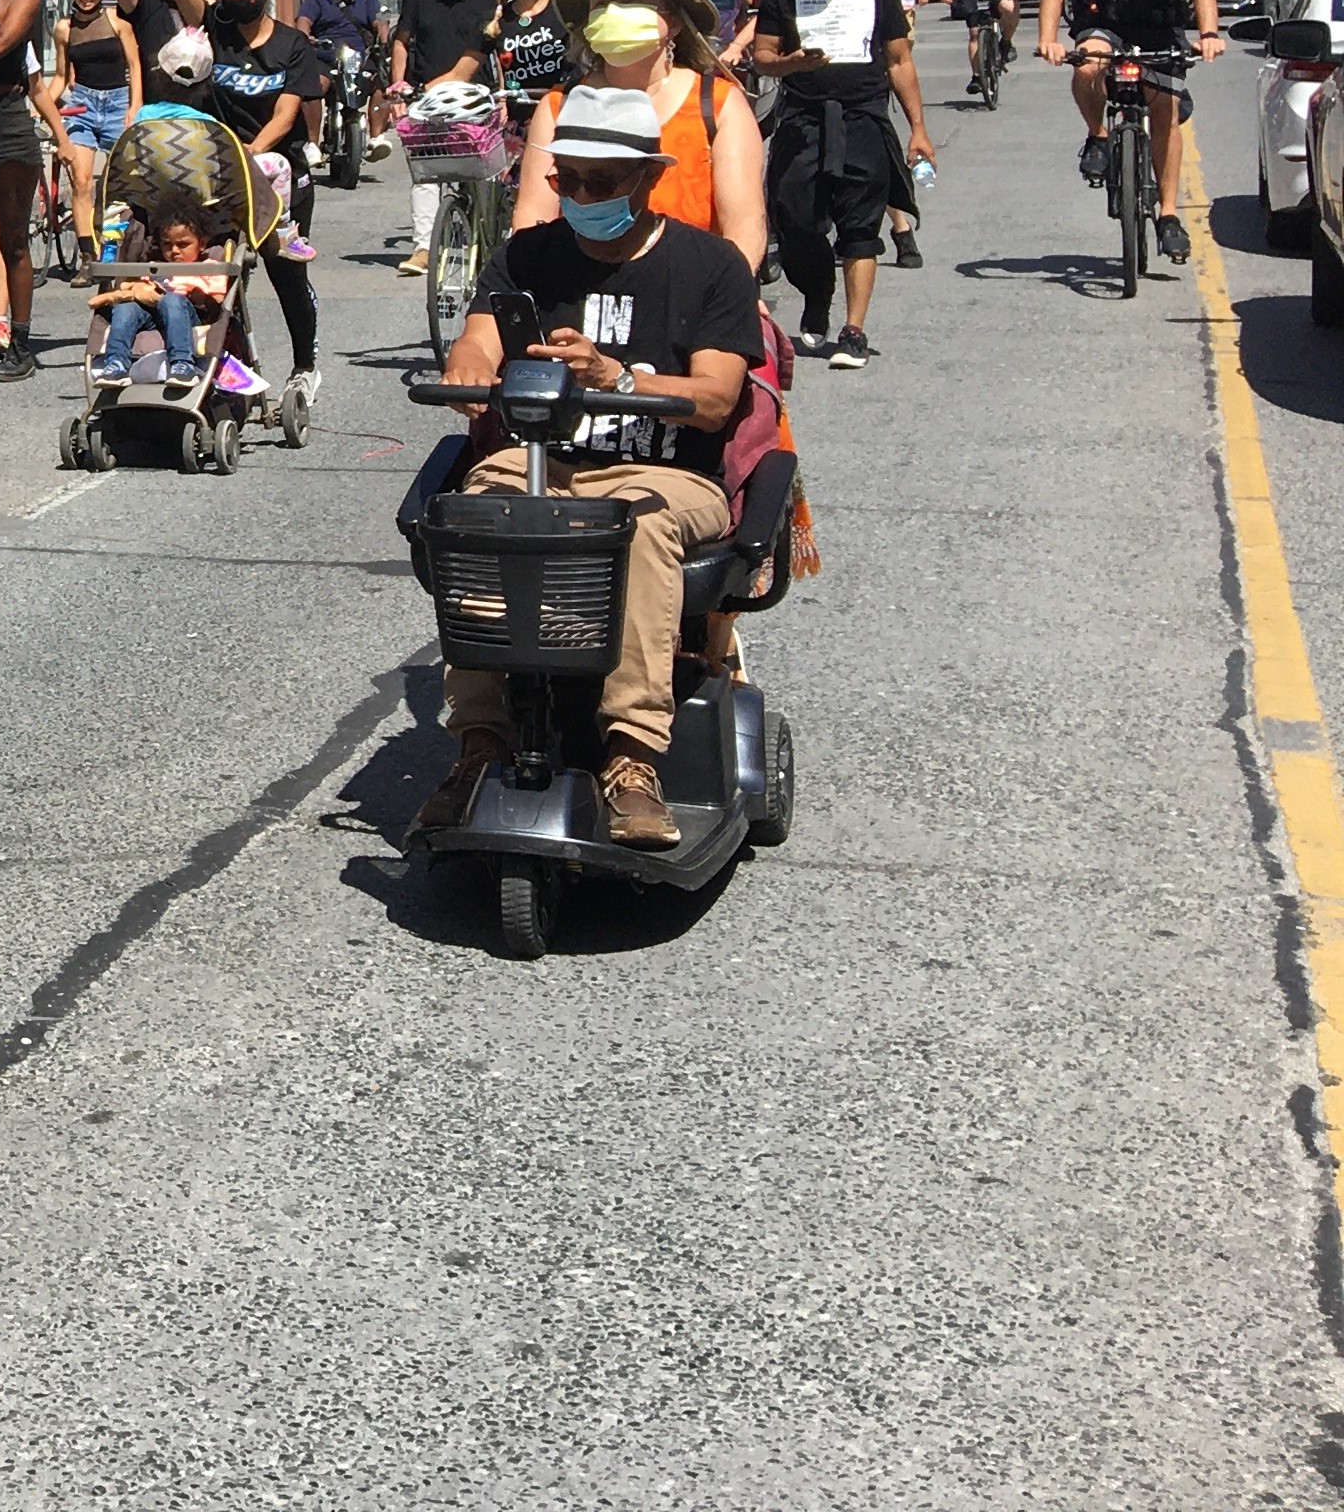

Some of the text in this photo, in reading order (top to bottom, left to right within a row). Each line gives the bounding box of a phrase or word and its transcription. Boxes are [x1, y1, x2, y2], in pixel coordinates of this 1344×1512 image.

[504, 26, 553, 53] black
[515, 40, 565, 65] lives
[504, 56, 564, 82] matter
[583, 293, 634, 345] IN
